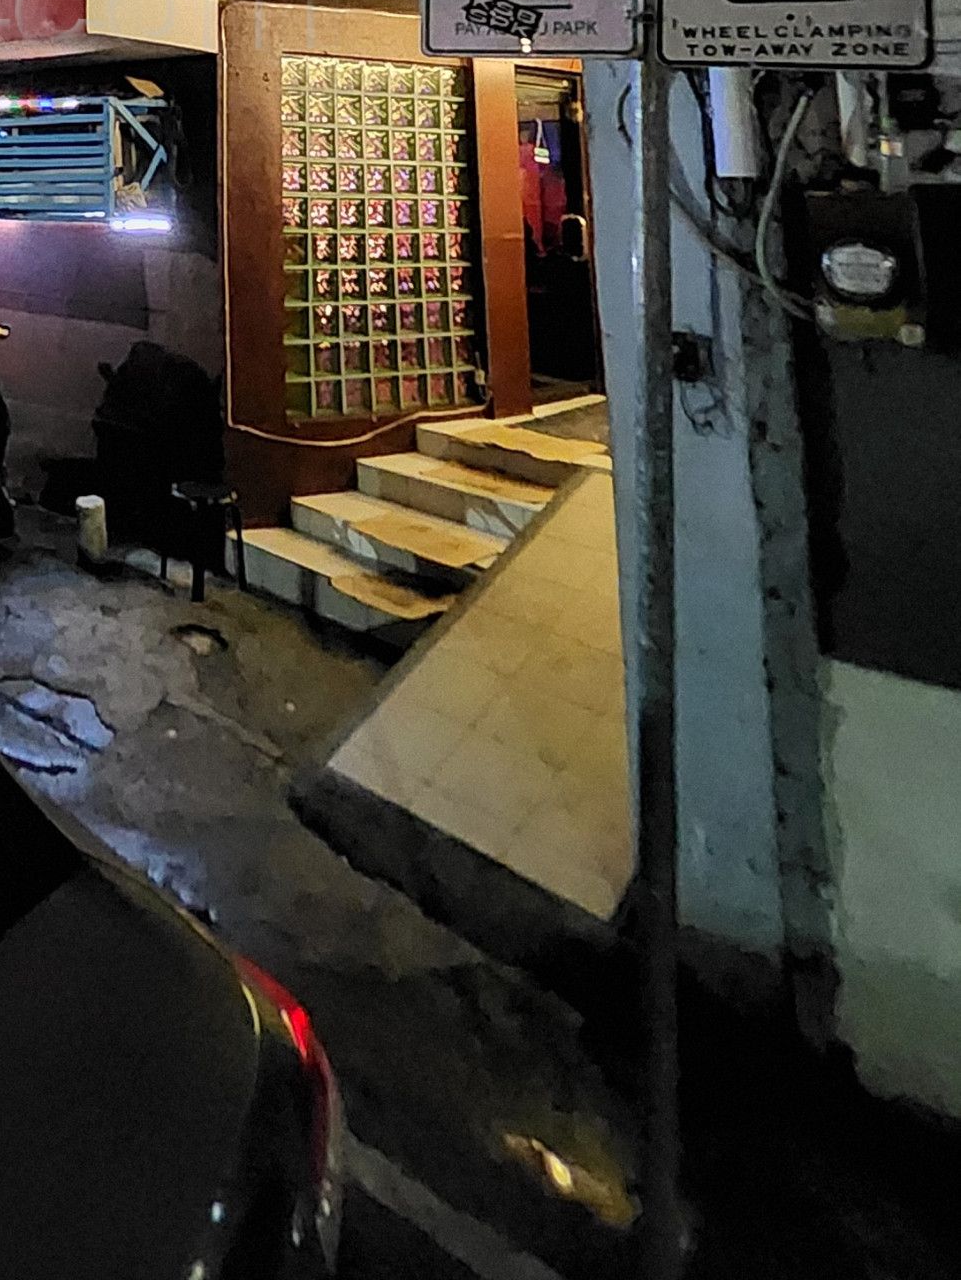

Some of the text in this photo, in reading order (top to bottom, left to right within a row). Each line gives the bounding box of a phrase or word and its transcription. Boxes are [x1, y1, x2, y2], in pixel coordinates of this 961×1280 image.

[683, 23, 912, 39] WHEEL CLAMPING
[687, 41, 910, 57] TOW-AWAY ZONE
